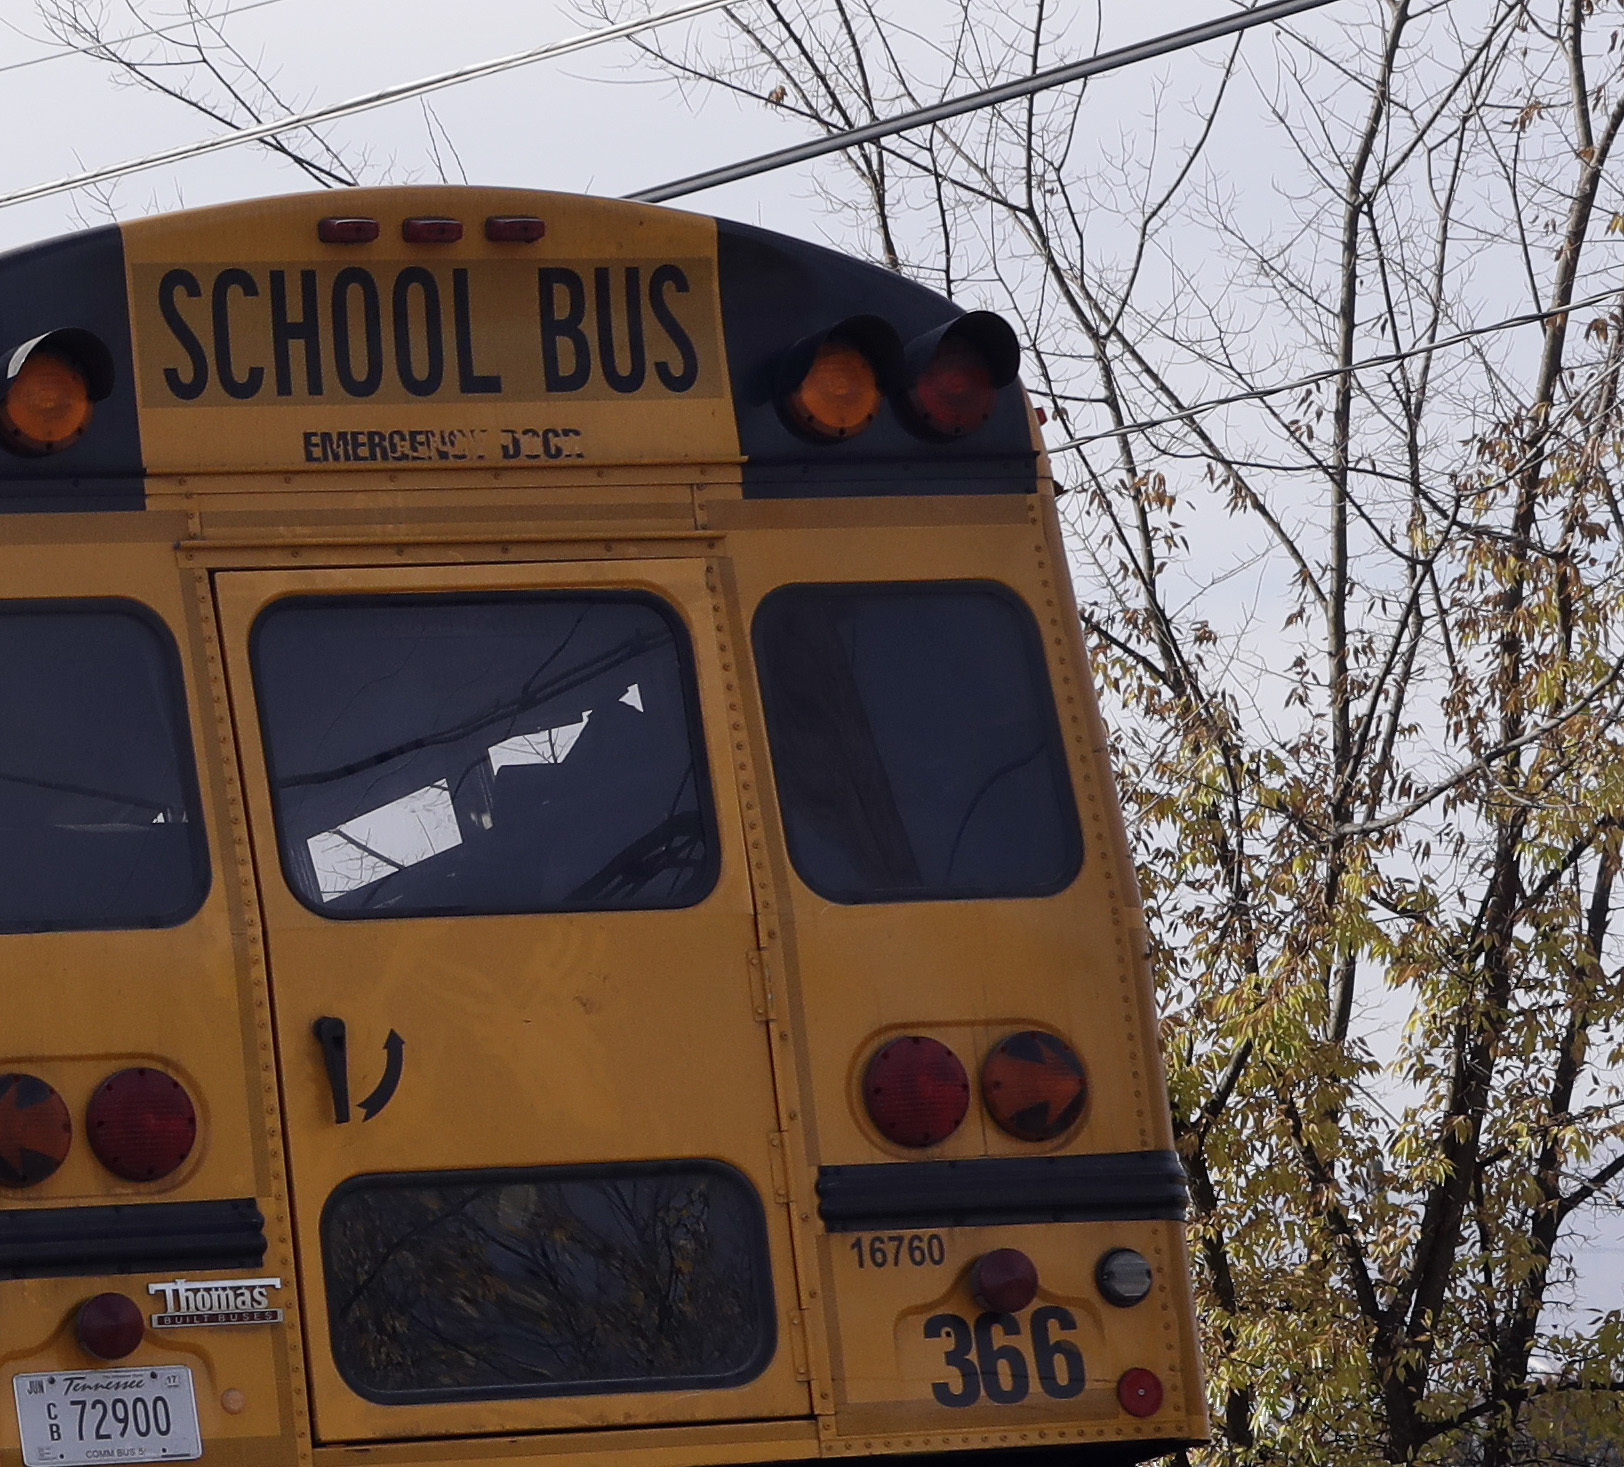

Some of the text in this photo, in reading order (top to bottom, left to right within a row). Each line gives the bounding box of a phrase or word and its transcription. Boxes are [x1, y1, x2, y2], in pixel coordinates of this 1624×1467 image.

[158, 263, 699, 400] SCHOOL BUS
[850, 1233, 946, 1269] 16760
[149, 1277, 281, 1312] Thomas
[163, 1310, 274, 1325] BUILT BUSES
[923, 1305, 1085, 1408] 366
[62, 1376, 146, 1396] Tennessee
[166, 1375, 177, 1385] 17
[69, 1395, 172, 1442] 72900
